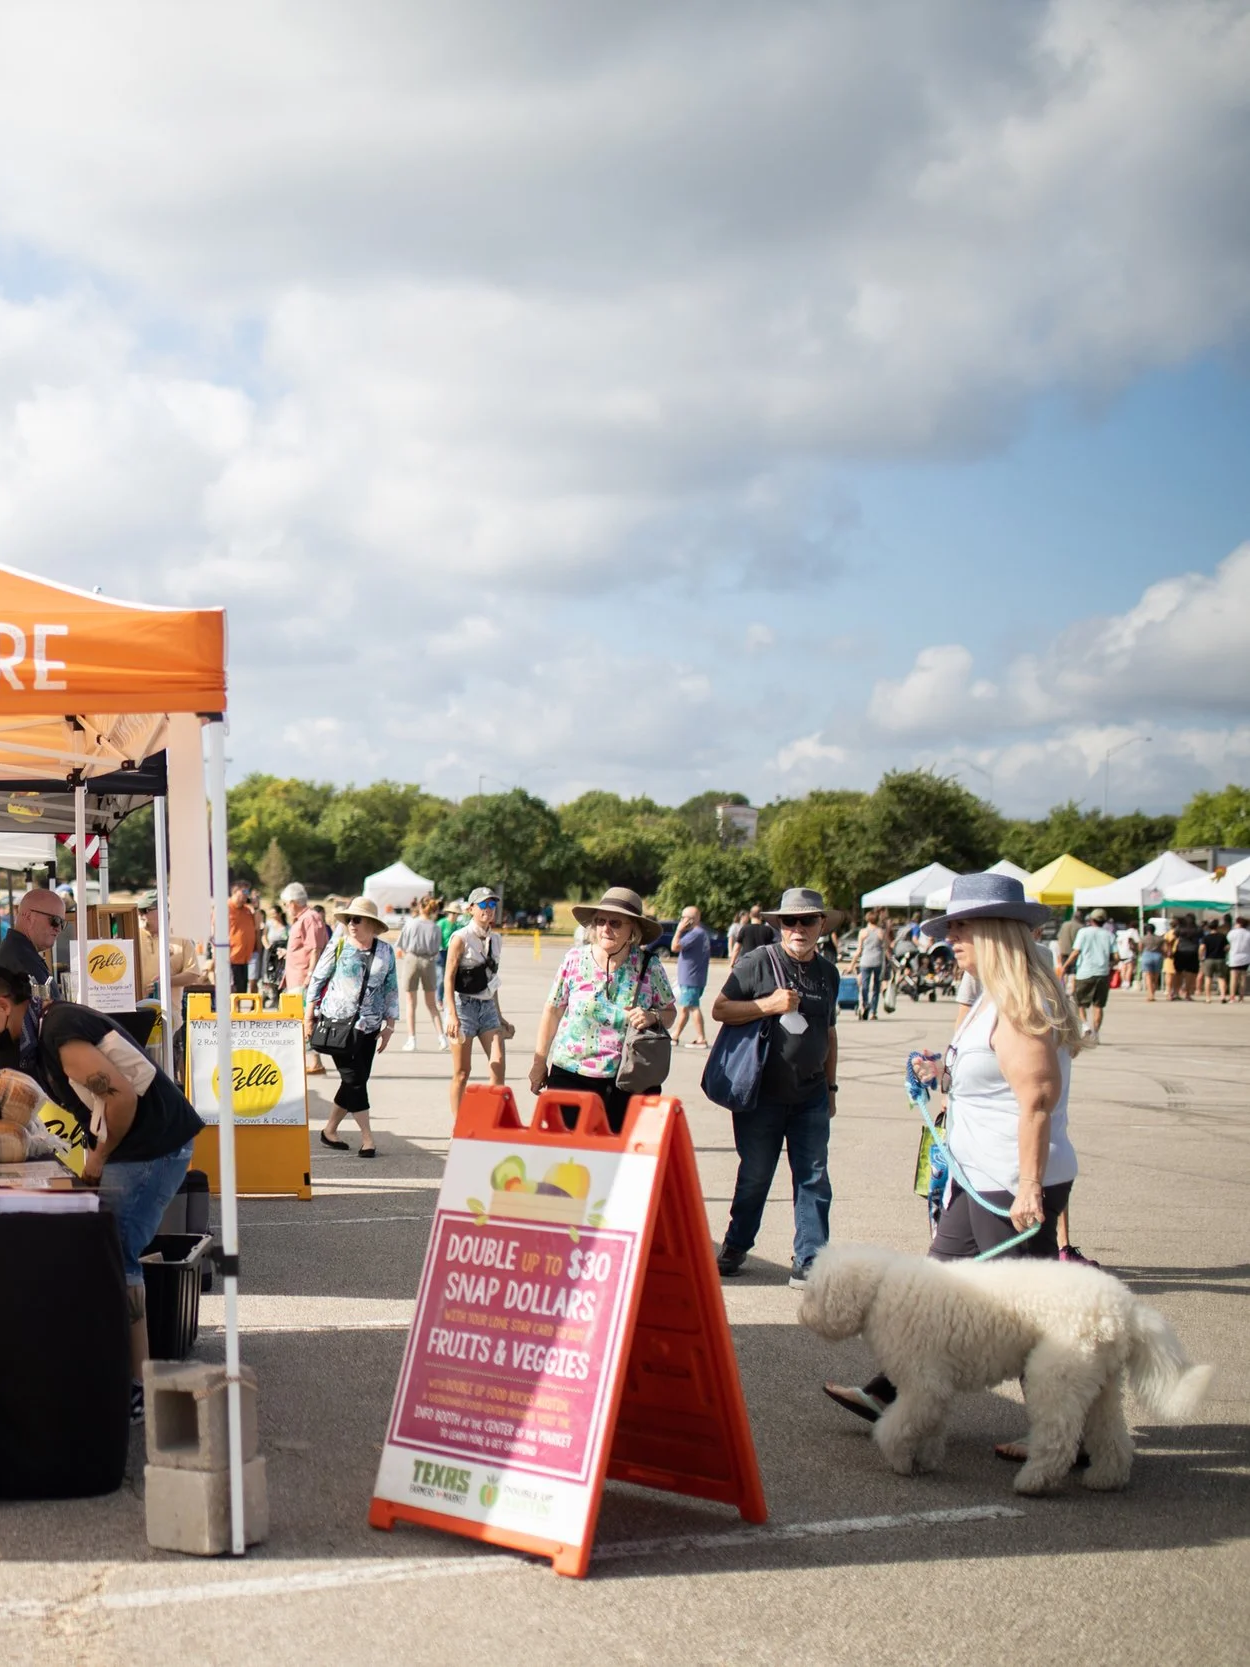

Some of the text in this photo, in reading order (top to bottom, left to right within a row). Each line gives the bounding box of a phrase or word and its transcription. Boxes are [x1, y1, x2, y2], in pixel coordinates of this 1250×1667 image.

[89, 953, 125, 974] Pella
[191, 1020, 211, 1029] WIN
[231, 1020, 246, 1029] ETI
[249, 1020, 275, 1030] PRIZE
[275, 1020, 299, 1029] PACK
[240, 1030, 250, 1038] 20
[446, 1234, 611, 1283] DOUBLE UP TO $30
[445, 1271, 596, 1322] SNAP DOLLARS
[426, 1327, 590, 1381] FRUITS & VEGGIES
[414, 1404, 434, 1422] INFO
[434, 1409, 461, 1427] BOOTH
[483, 1418, 515, 1438] CENTER
[413, 1459, 472, 1495] TEXAS
